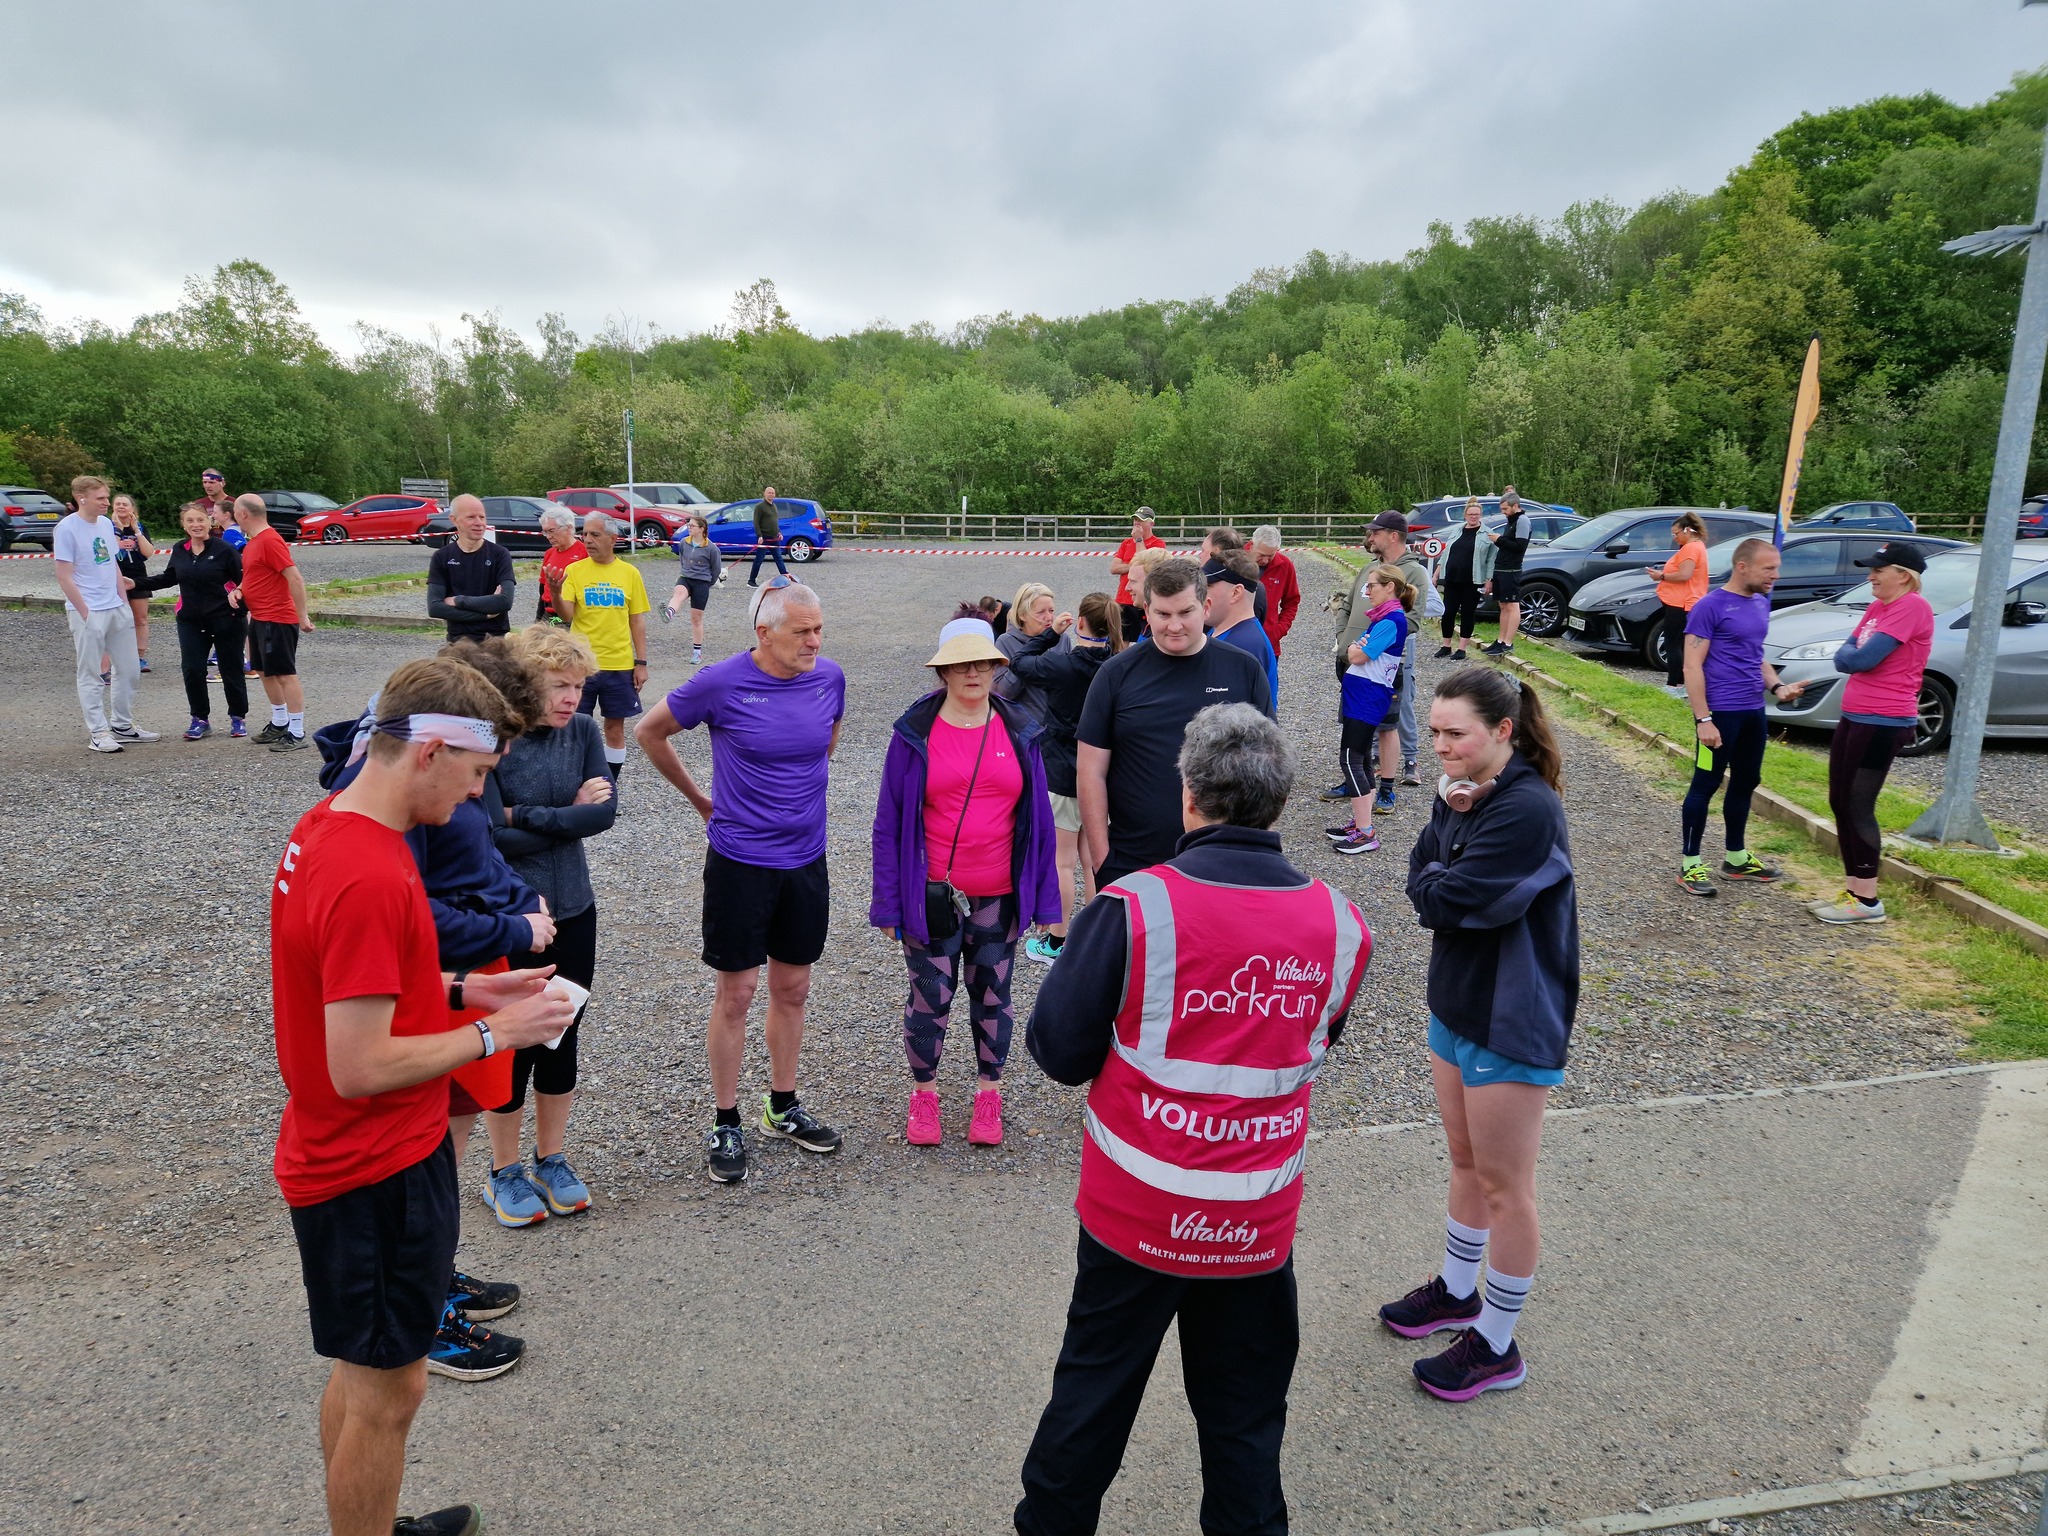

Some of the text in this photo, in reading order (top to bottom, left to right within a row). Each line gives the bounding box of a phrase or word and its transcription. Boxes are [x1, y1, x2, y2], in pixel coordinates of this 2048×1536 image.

[1429, 542, 1437, 554] 5
[585, 592, 625, 607] RUN
[743, 694, 768, 703] parkrun
[1275, 956, 1326, 988] Vitality
[1181, 974, 1317, 1019] parkrun
[1141, 1092, 1304, 1142] VOLUNTEER
[1170, 1211, 1258, 1251] Vitality
[1138, 1241, 1276, 1264] HEALTH AND LIFE INSURANCE
